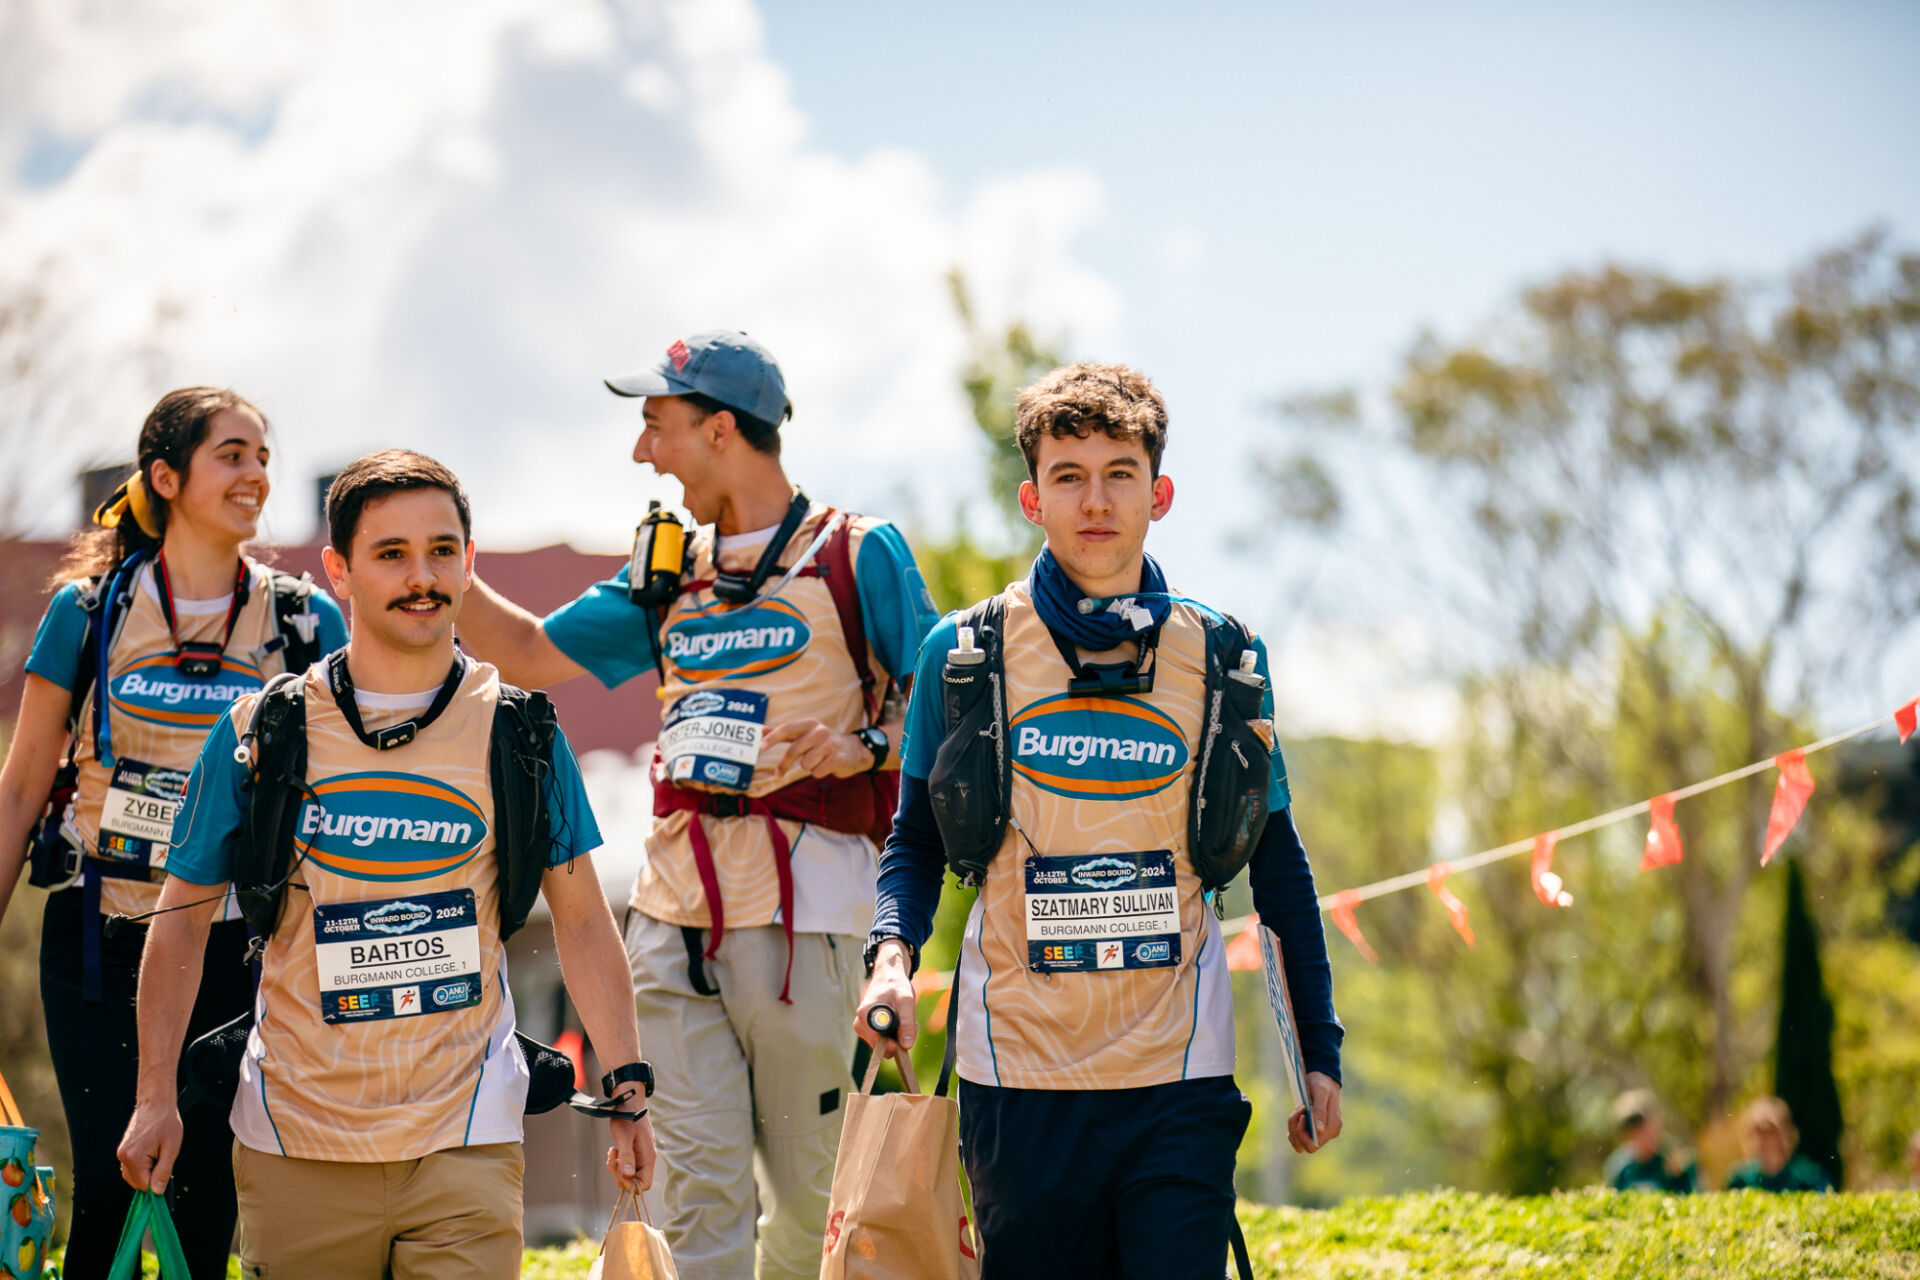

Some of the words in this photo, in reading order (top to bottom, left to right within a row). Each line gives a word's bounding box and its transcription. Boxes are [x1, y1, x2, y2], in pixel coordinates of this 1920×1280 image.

[668, 626, 795, 660] Burgmann
[727, 701, 755, 713] 2024
[1017, 727, 1177, 766] Burgmann
[124, 797, 178, 820] ZYBE
[302, 804, 472, 847] Burgmann
[1035, 870, 1066, 878] 11-12TH
[1078, 870, 1106, 878] INWARD
[1107, 868, 1132, 877] BOUND
[1140, 866, 1165, 877] 2024
[1031, 897, 1109, 917] SZATMARY
[1113, 892, 1174, 913] SULLIVAN
[325, 918, 358, 927] 11-12TH
[370, 914, 400, 925] INWARD
[400, 911, 427, 921] BOUND
[436, 906, 465, 919] 2024
[324, 924, 361, 934] OCTOBER
[1041, 924, 1107, 936] BURGMANN
[350, 936, 445, 964] BARTOS
[1043, 945, 1083, 960] SEEF
[334, 970, 402, 986] BURGMANN
[448, 985, 465, 995] ANU
[337, 993, 380, 1011] SEEF
